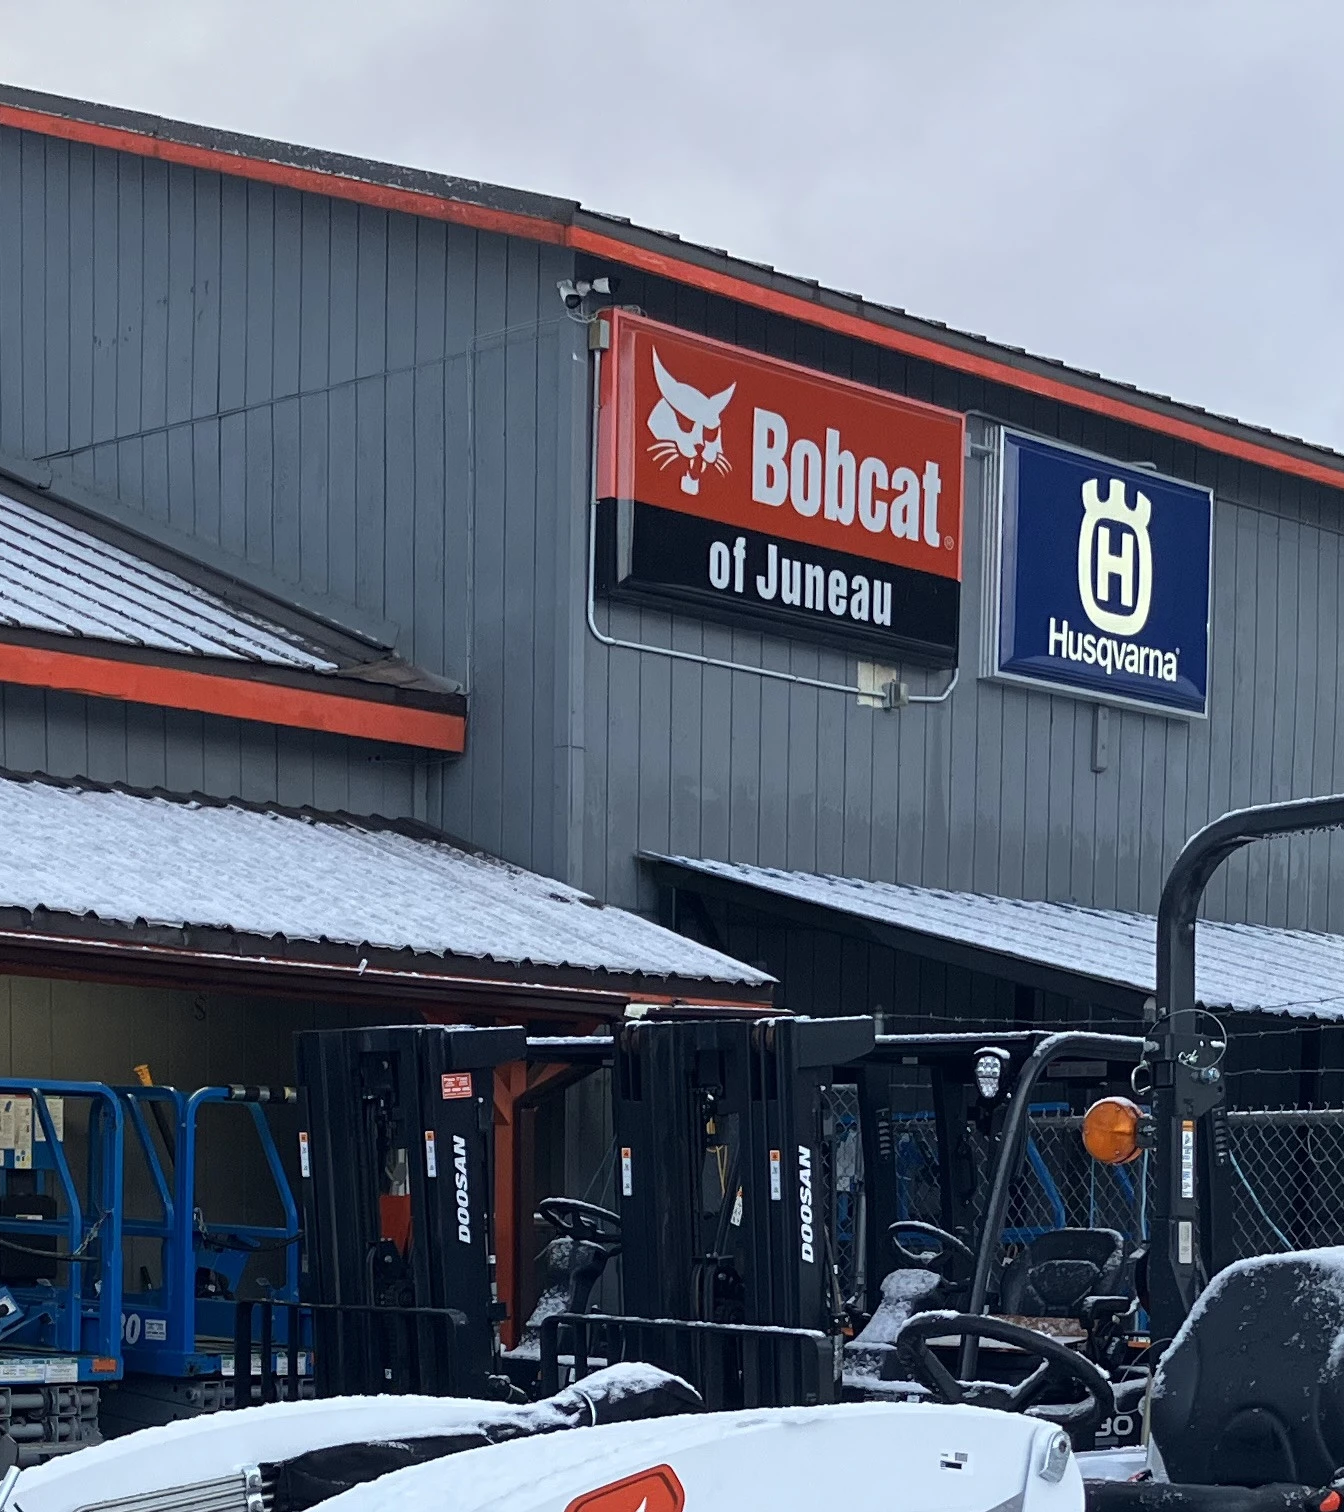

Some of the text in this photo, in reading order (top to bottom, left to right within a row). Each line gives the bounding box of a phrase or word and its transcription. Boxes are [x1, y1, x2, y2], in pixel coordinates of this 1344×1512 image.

[752, 407, 941, 547] Bobcat
[709, 537, 892, 626] of Juneau
[1048, 617, 1177, 682] Husqvarna
[453, 1135, 471, 1244] DOOSAN
[798, 1145, 815, 1263] DOOSAN
